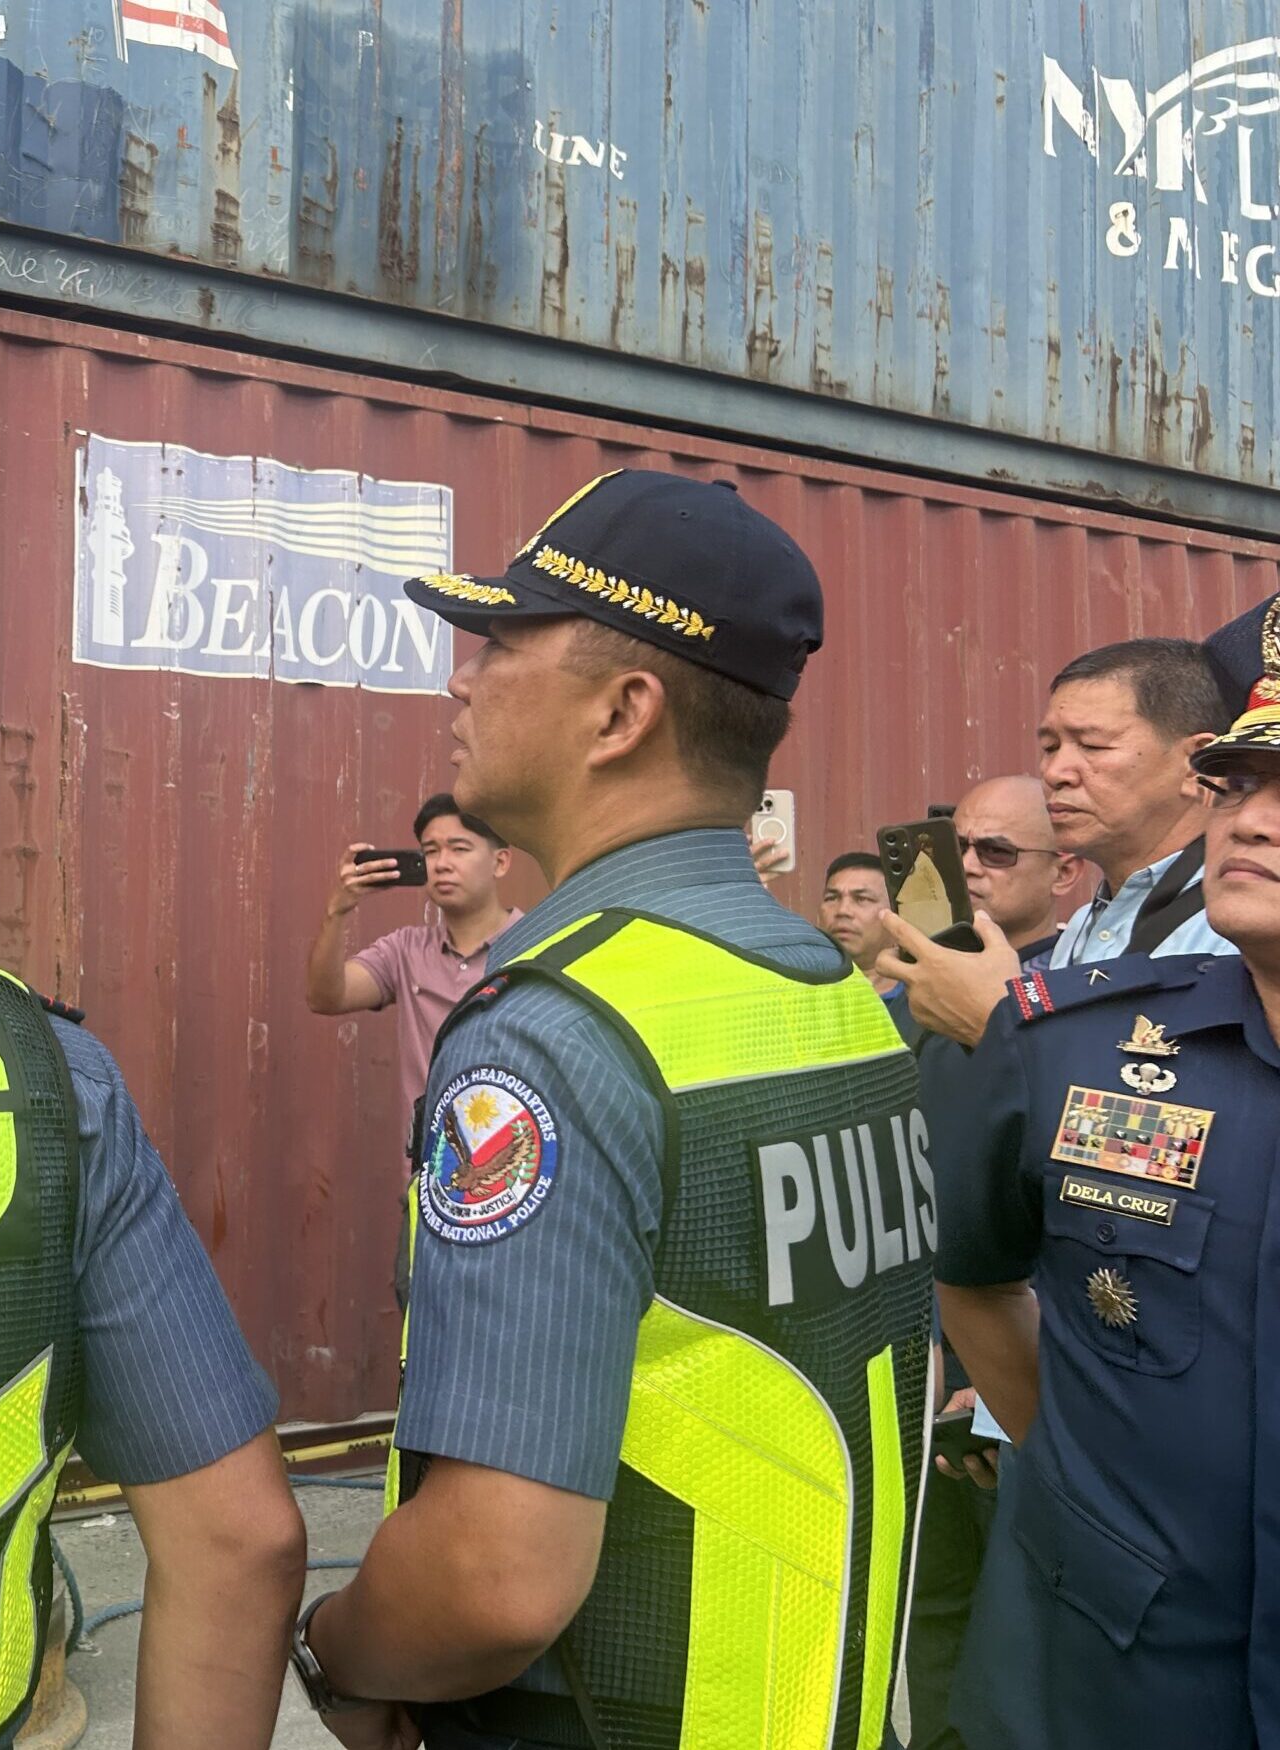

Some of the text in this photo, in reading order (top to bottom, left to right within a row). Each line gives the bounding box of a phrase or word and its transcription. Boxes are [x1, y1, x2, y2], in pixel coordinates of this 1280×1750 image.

[1106, 201, 1141, 256] &
[130, 534, 442, 674] BEACON
[1023, 981, 1040, 1003] PNP
[431, 1068, 557, 1142] NATIONAL HEADQUARTERS
[440, 1221, 508, 1242] NATIONAL
[506, 1175, 553, 1229] POLICE
[758, 1108, 938, 1306] PULIS
[1066, 1182, 1169, 1217] DELA CRUZ
